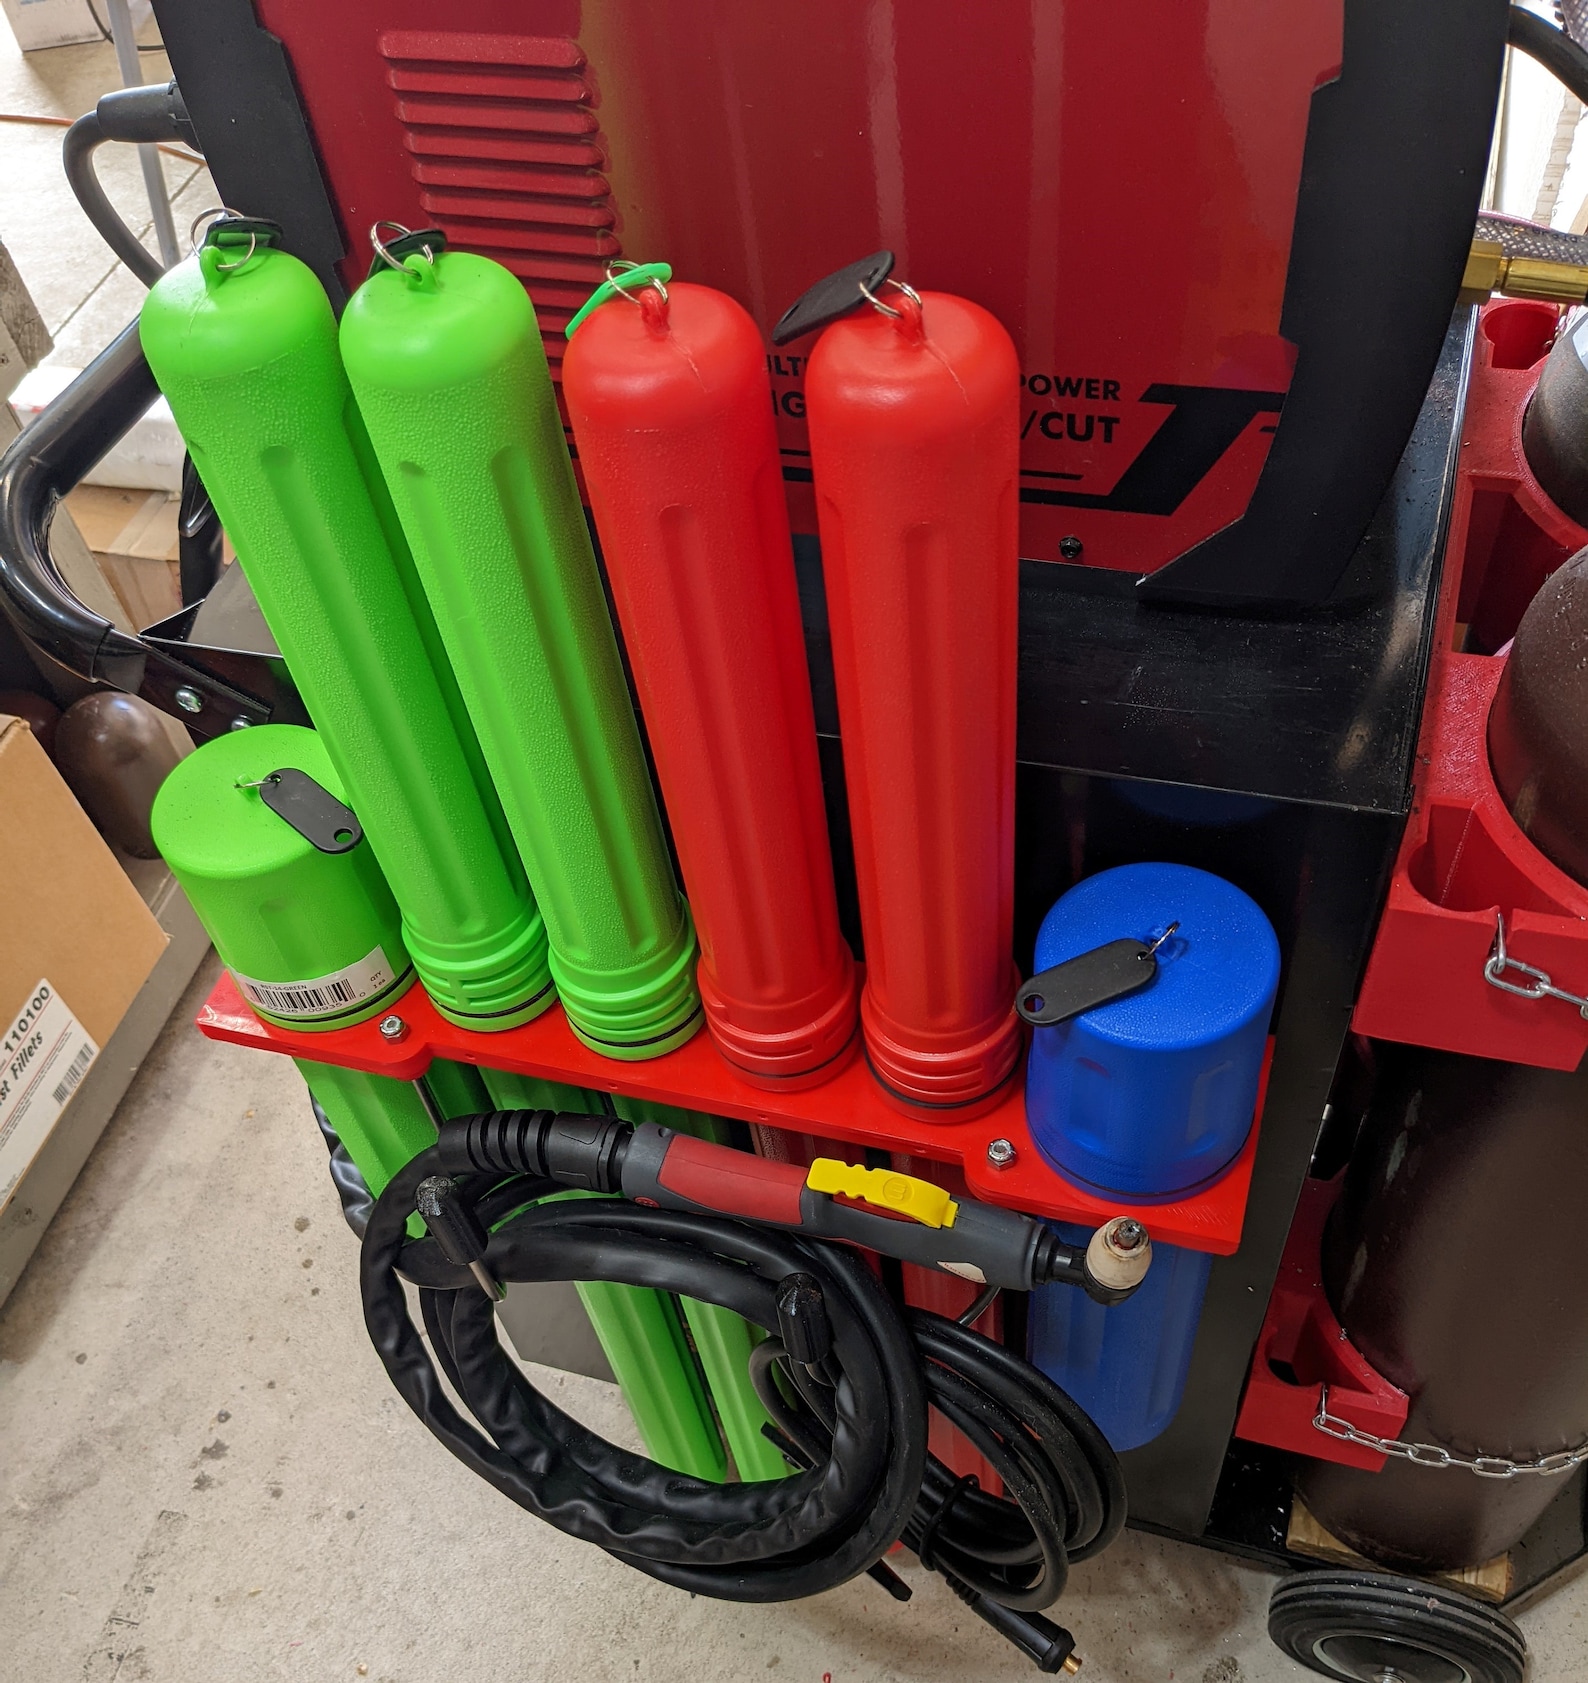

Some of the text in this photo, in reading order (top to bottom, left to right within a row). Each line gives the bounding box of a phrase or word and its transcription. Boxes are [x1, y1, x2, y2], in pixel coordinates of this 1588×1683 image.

[370, 970, 382, 982] QTY
[5, 986, 50, 1053] 110100
[10, 1031, 43, 1080] Fillets
